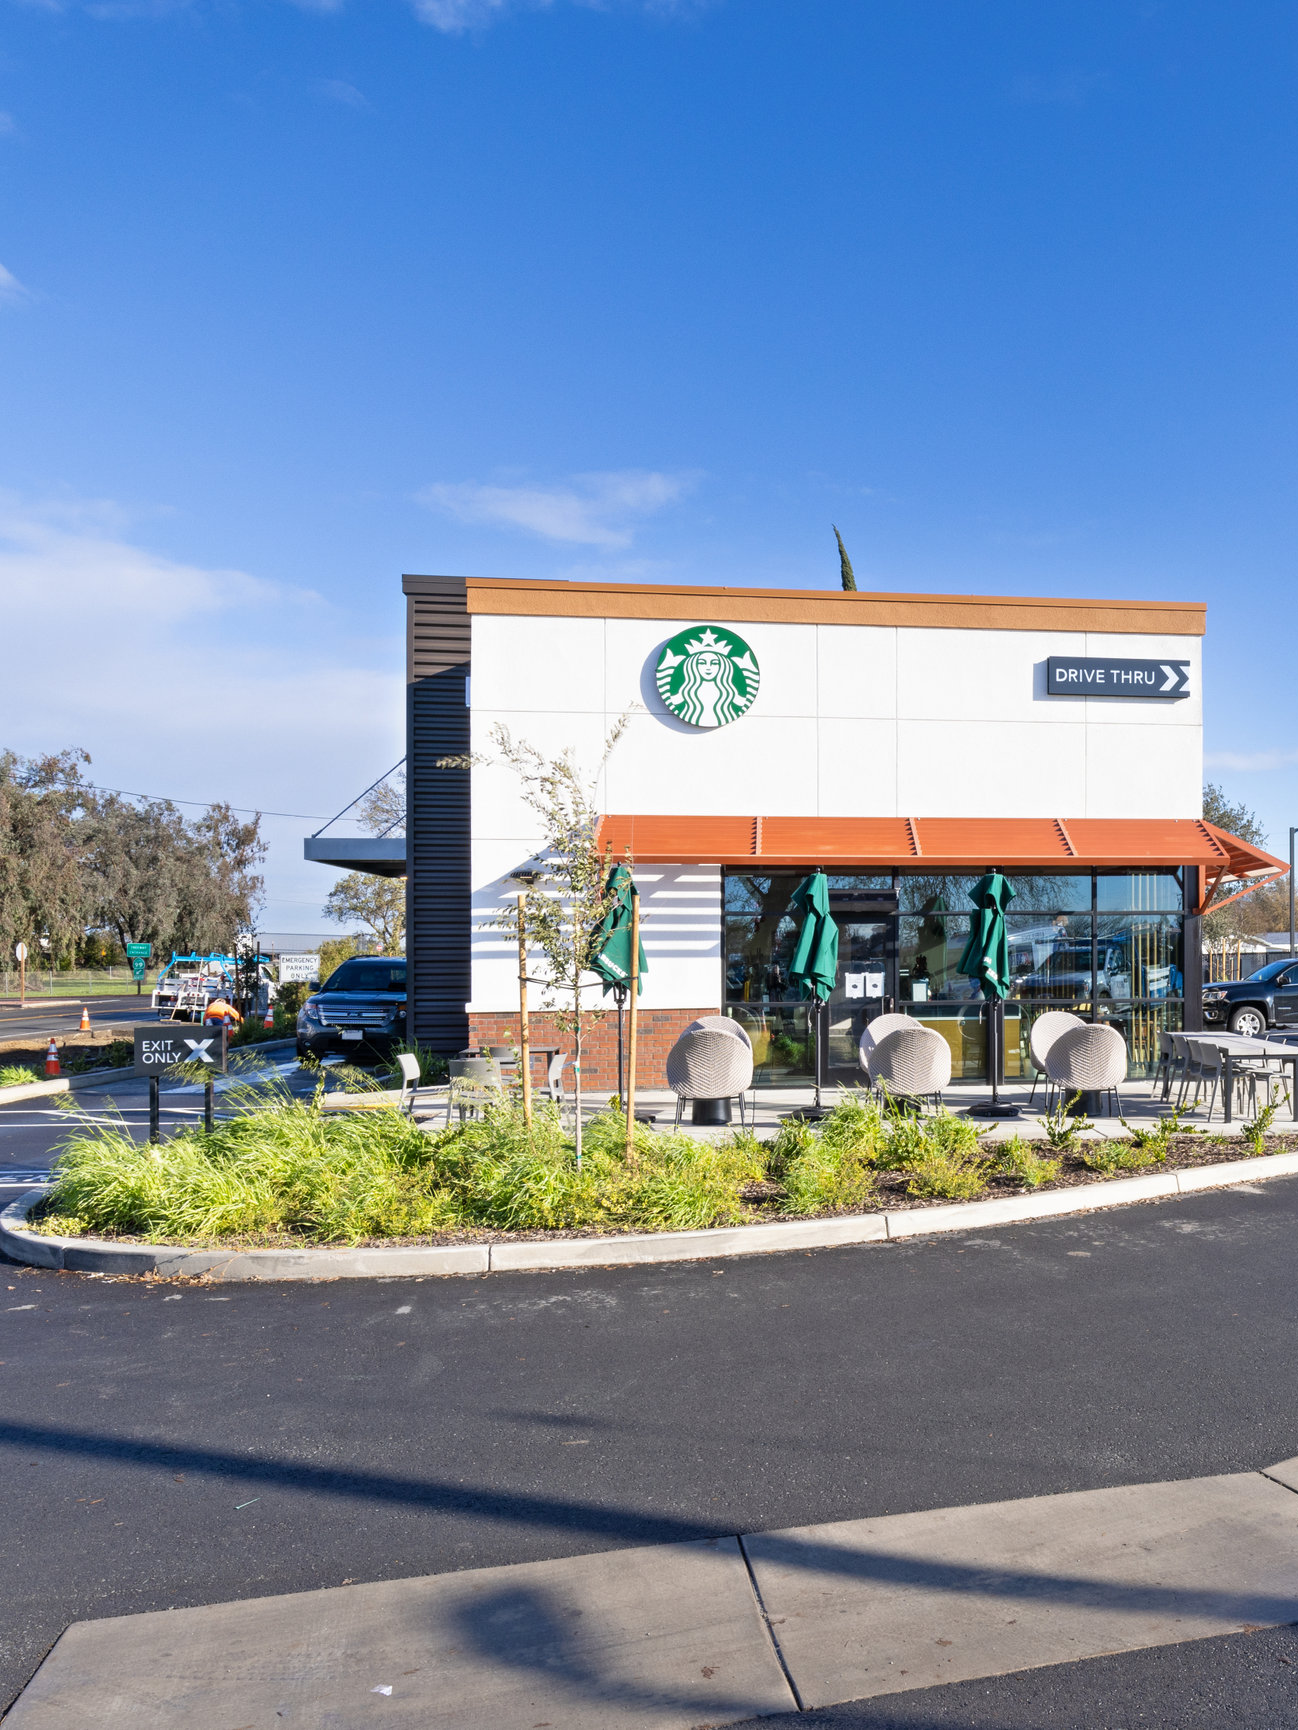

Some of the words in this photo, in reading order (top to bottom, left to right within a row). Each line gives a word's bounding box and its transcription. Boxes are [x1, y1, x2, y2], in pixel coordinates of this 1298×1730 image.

[1055, 668, 1106, 683] DRIVE
[1110, 670, 1155, 684] THRU
[142, 1040, 174, 1052] EXIT
[142, 1052, 182, 1064] ONLY
